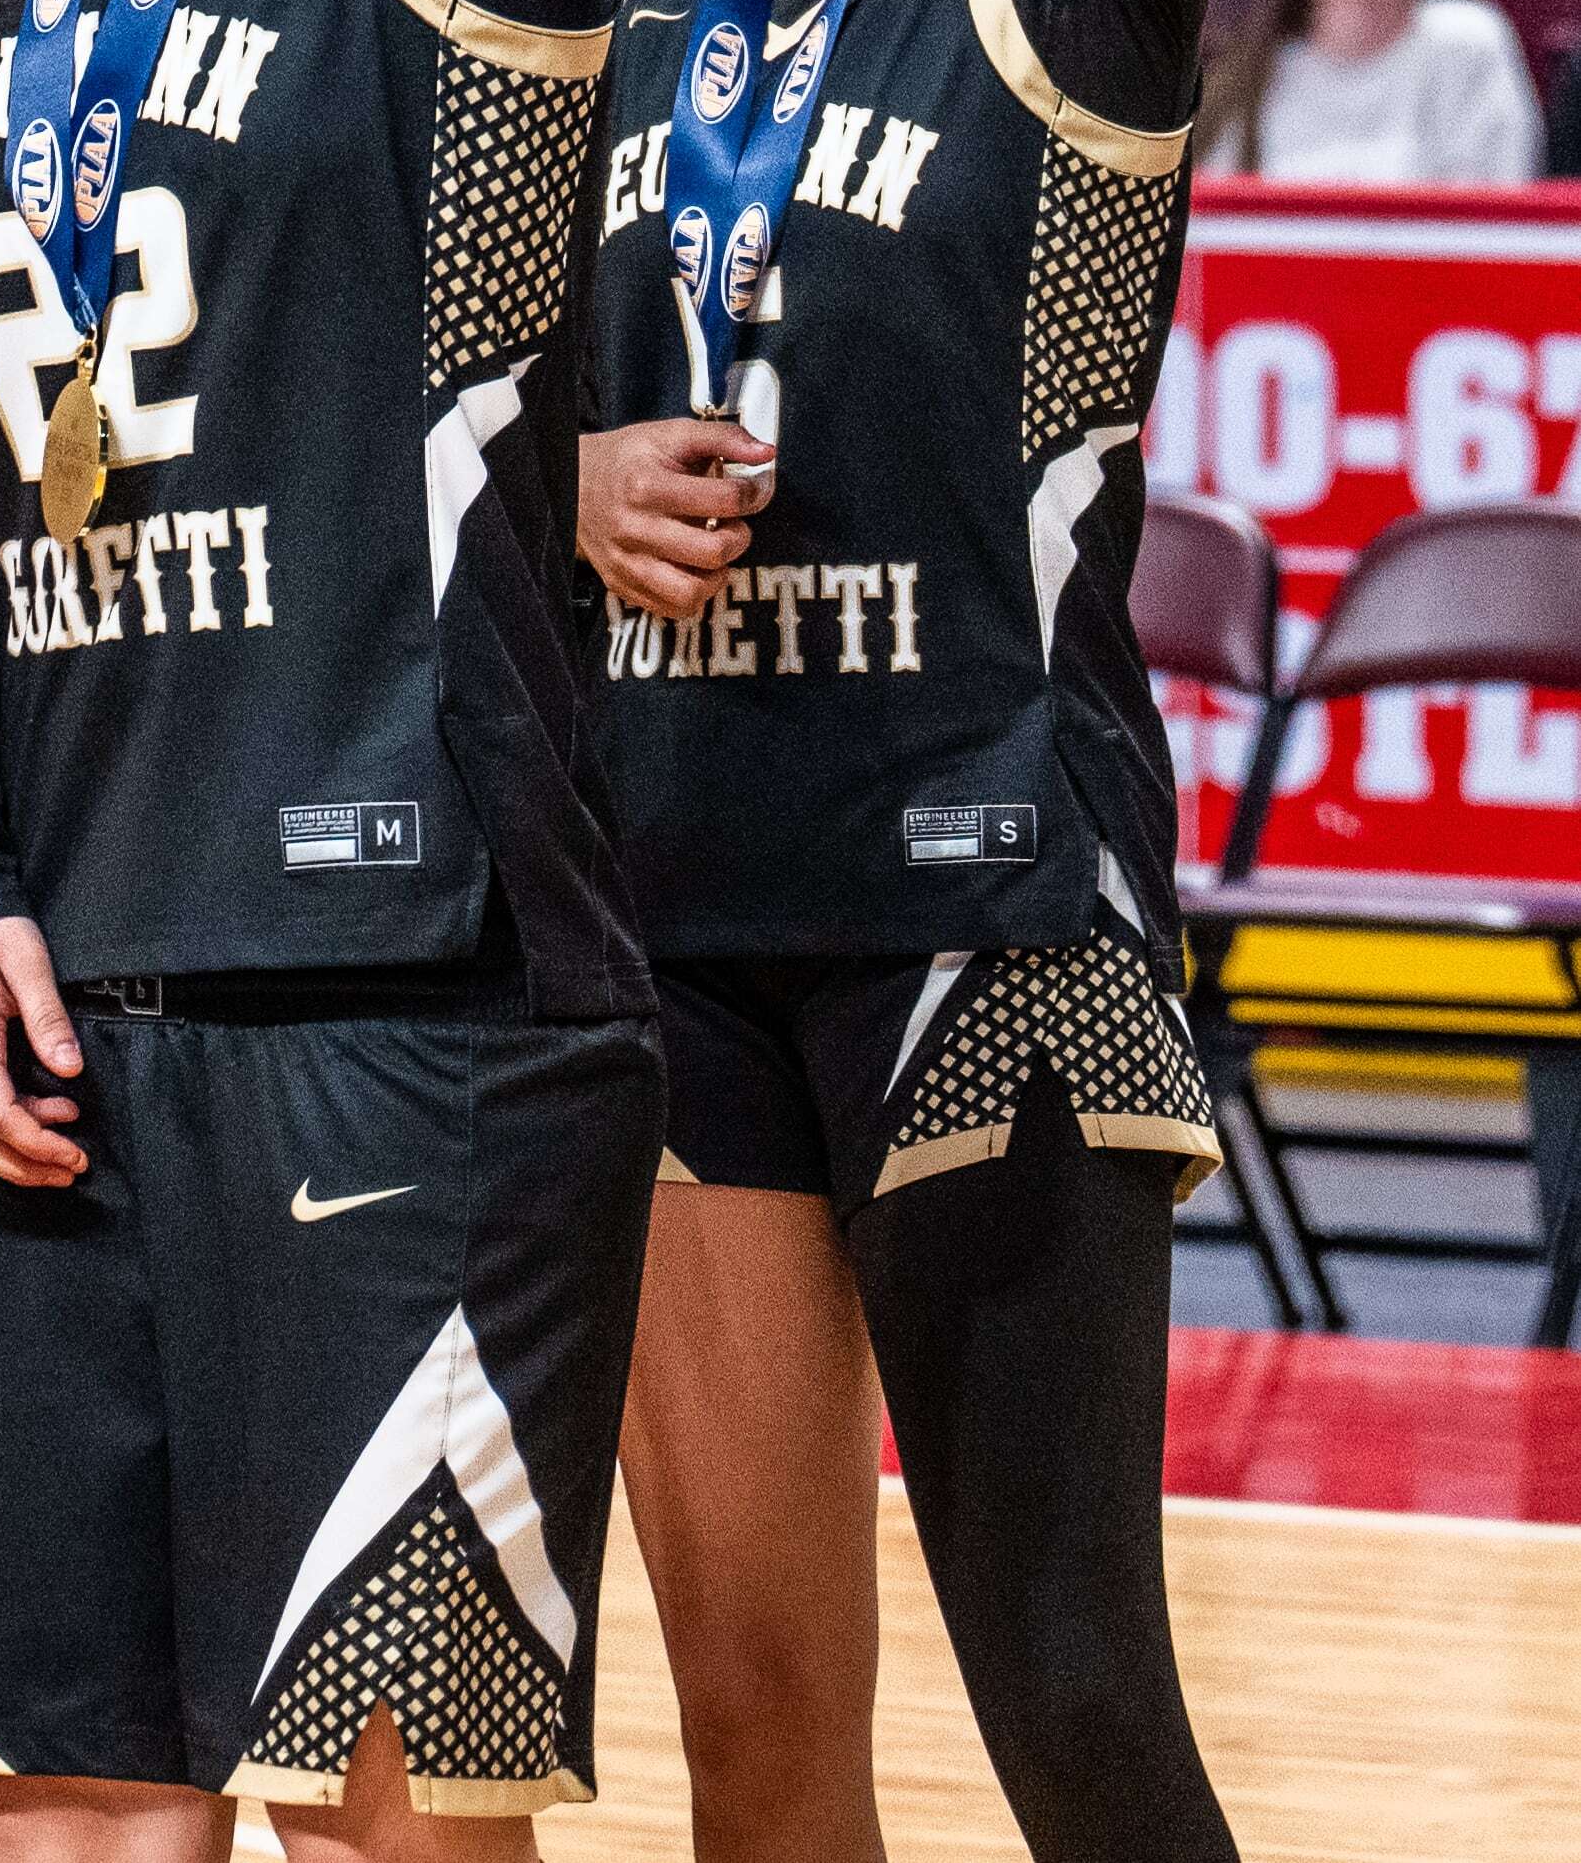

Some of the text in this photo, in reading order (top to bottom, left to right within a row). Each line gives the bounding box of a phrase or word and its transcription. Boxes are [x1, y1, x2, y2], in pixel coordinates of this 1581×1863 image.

[697, 29, 743, 117] PIAA
[19, 123, 54, 241] PIAA
[74, 109, 118, 227] PIAA
[728, 207, 765, 313] PIAA
[283, 808, 356, 824] ENGINEERED
[375, 818, 402, 846] M
[909, 810, 979, 824] ENGINEERED
[999, 820, 1019, 844] S
